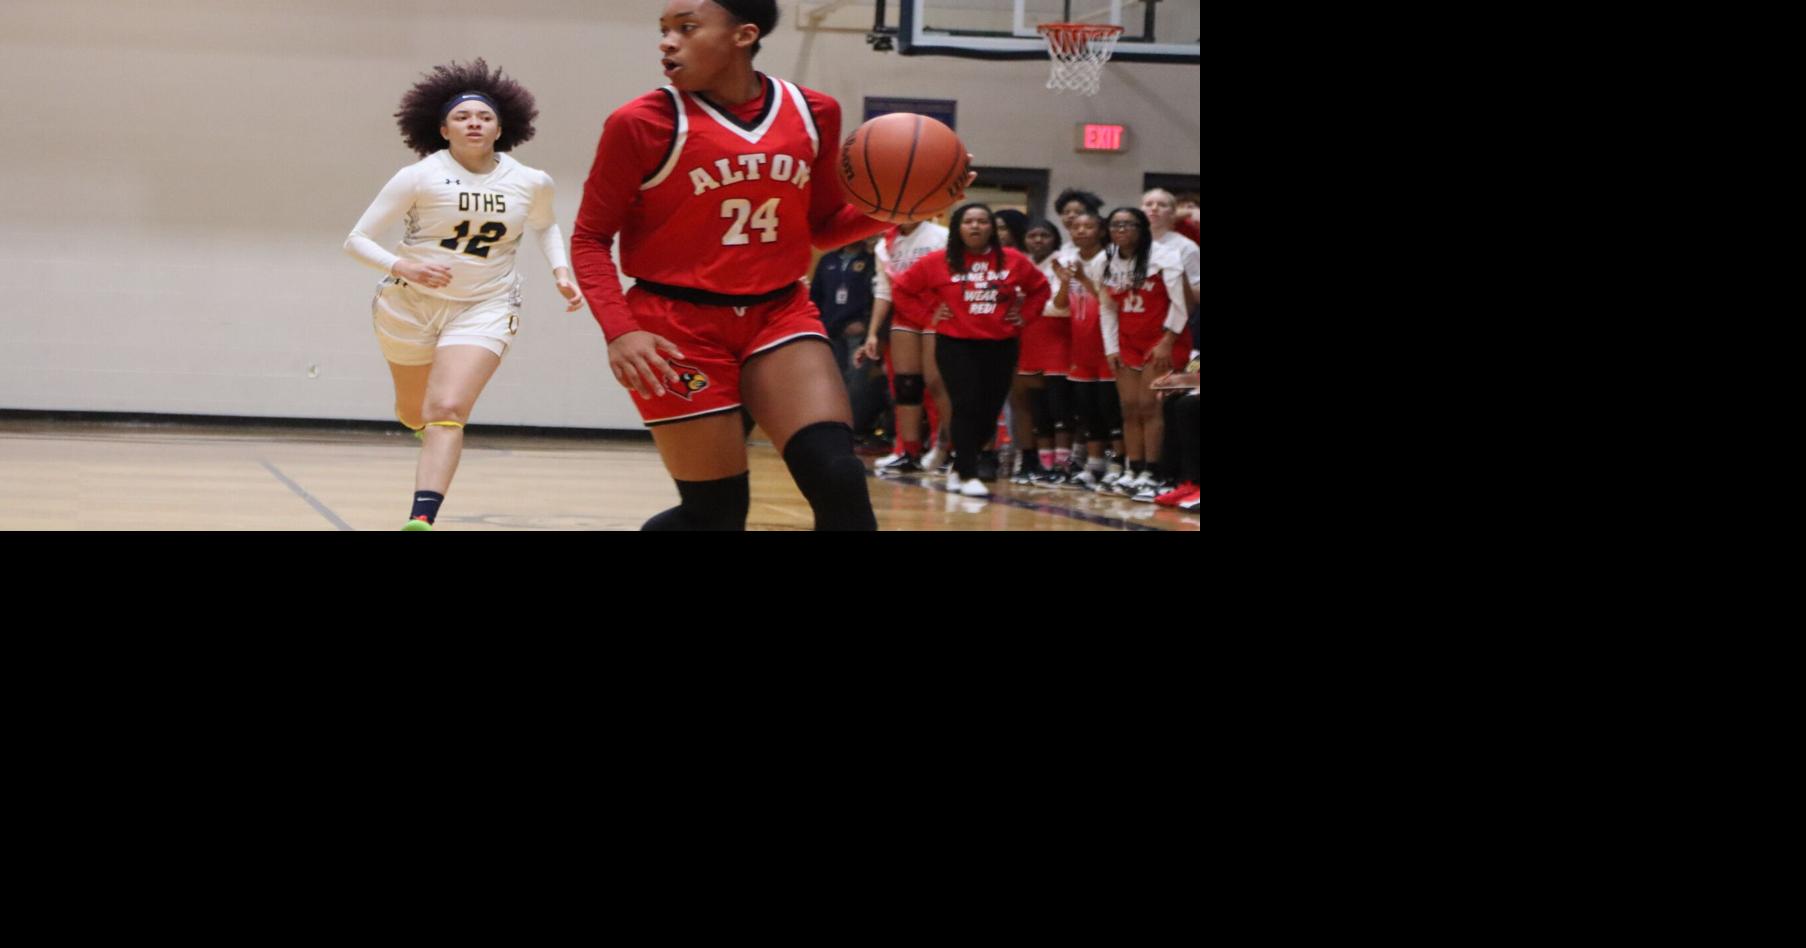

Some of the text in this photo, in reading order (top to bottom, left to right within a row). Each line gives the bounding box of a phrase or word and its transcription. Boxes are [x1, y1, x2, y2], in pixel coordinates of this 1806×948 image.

[1084, 124, 1123, 149] EXIT
[459, 192, 506, 213] OTHS
[721, 197, 781, 246] 24
[439, 220, 507, 259] 12
[963, 290, 999, 302] WEAR
